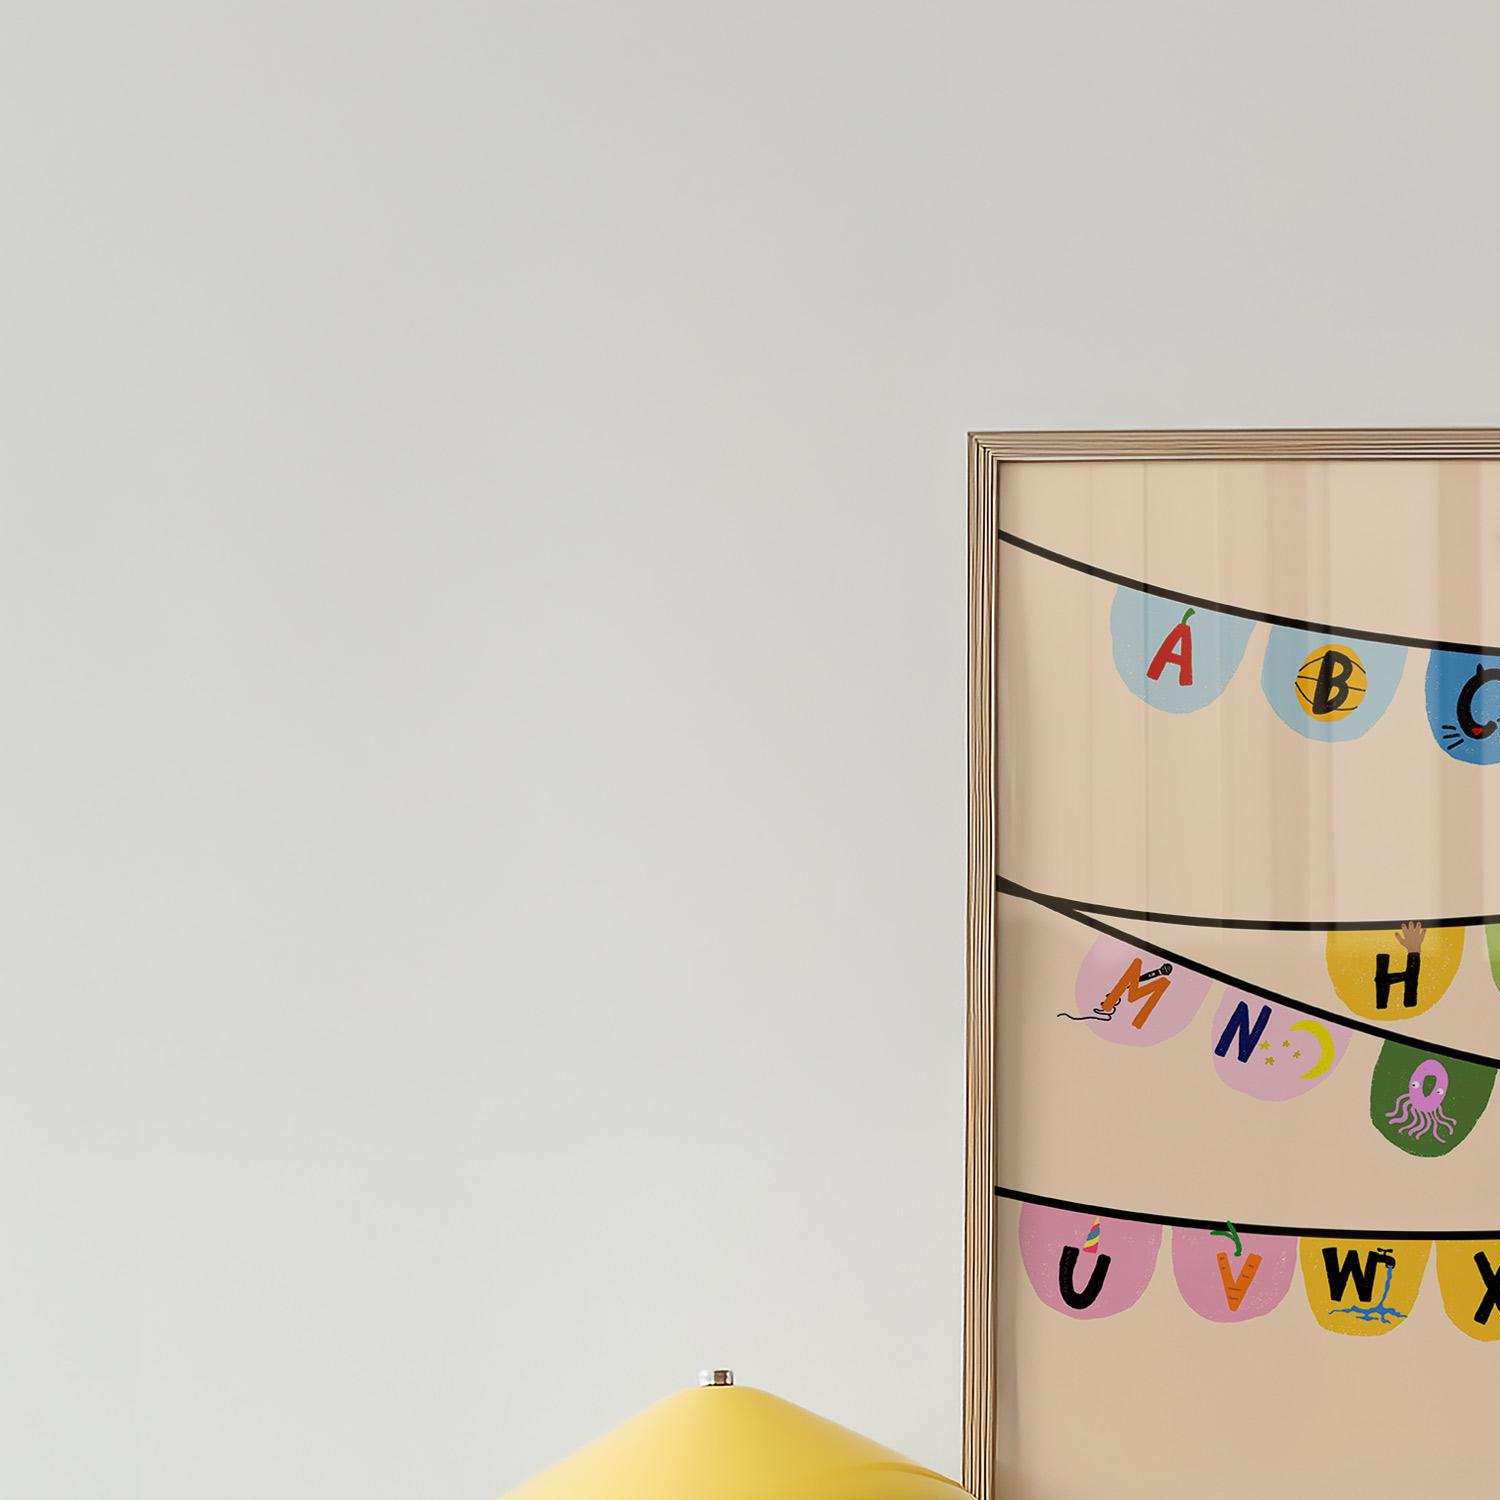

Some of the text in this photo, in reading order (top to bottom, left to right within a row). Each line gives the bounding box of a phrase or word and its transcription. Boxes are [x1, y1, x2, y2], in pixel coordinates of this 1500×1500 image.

[1146, 621, 1194, 687] A
[1312, 650, 1353, 715] B
[1101, 958, 1171, 1029] M
[1214, 1001, 1272, 1063] N
[1375, 952, 1421, 1010] H
[1058, 1246, 1111, 1310] U
[1217, 1252, 1263, 1312] V
[1321, 1247, 1379, 1302] W
